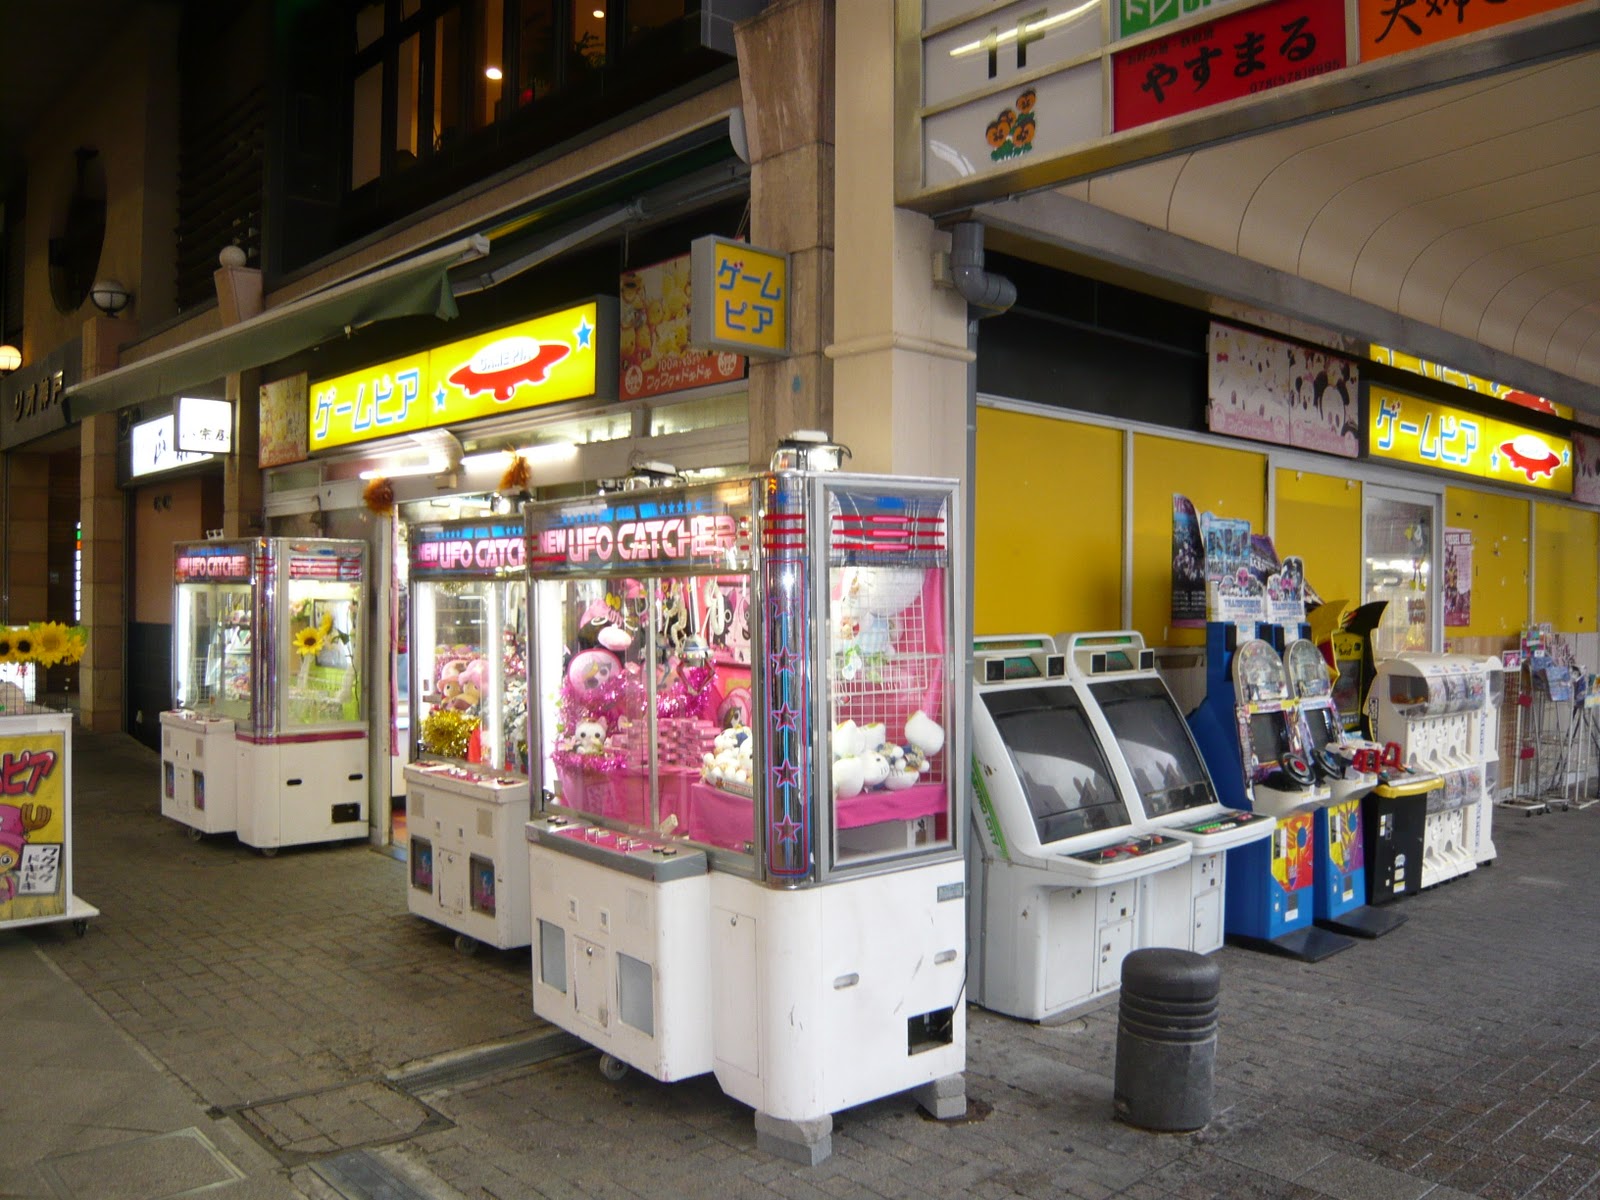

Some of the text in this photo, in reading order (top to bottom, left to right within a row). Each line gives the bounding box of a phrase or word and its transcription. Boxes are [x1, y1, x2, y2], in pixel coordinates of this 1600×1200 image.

[988, 8, 1047, 79] 1F
[1141, 16, 1316, 104] やすまる
[718, 258, 782, 301] ゲーム
[725, 300, 774, 334] ピア
[315, 368, 419, 439] ゲームピア
[1376, 399, 1478, 465] ゲームピア
[417, 542, 438, 562] NEW
[439, 541, 473, 570] UFO
[538, 515, 737, 563] NEW UFO CATCHER
[189, 556, 206, 577] UFO
[207, 555, 247, 577] CATCHER
